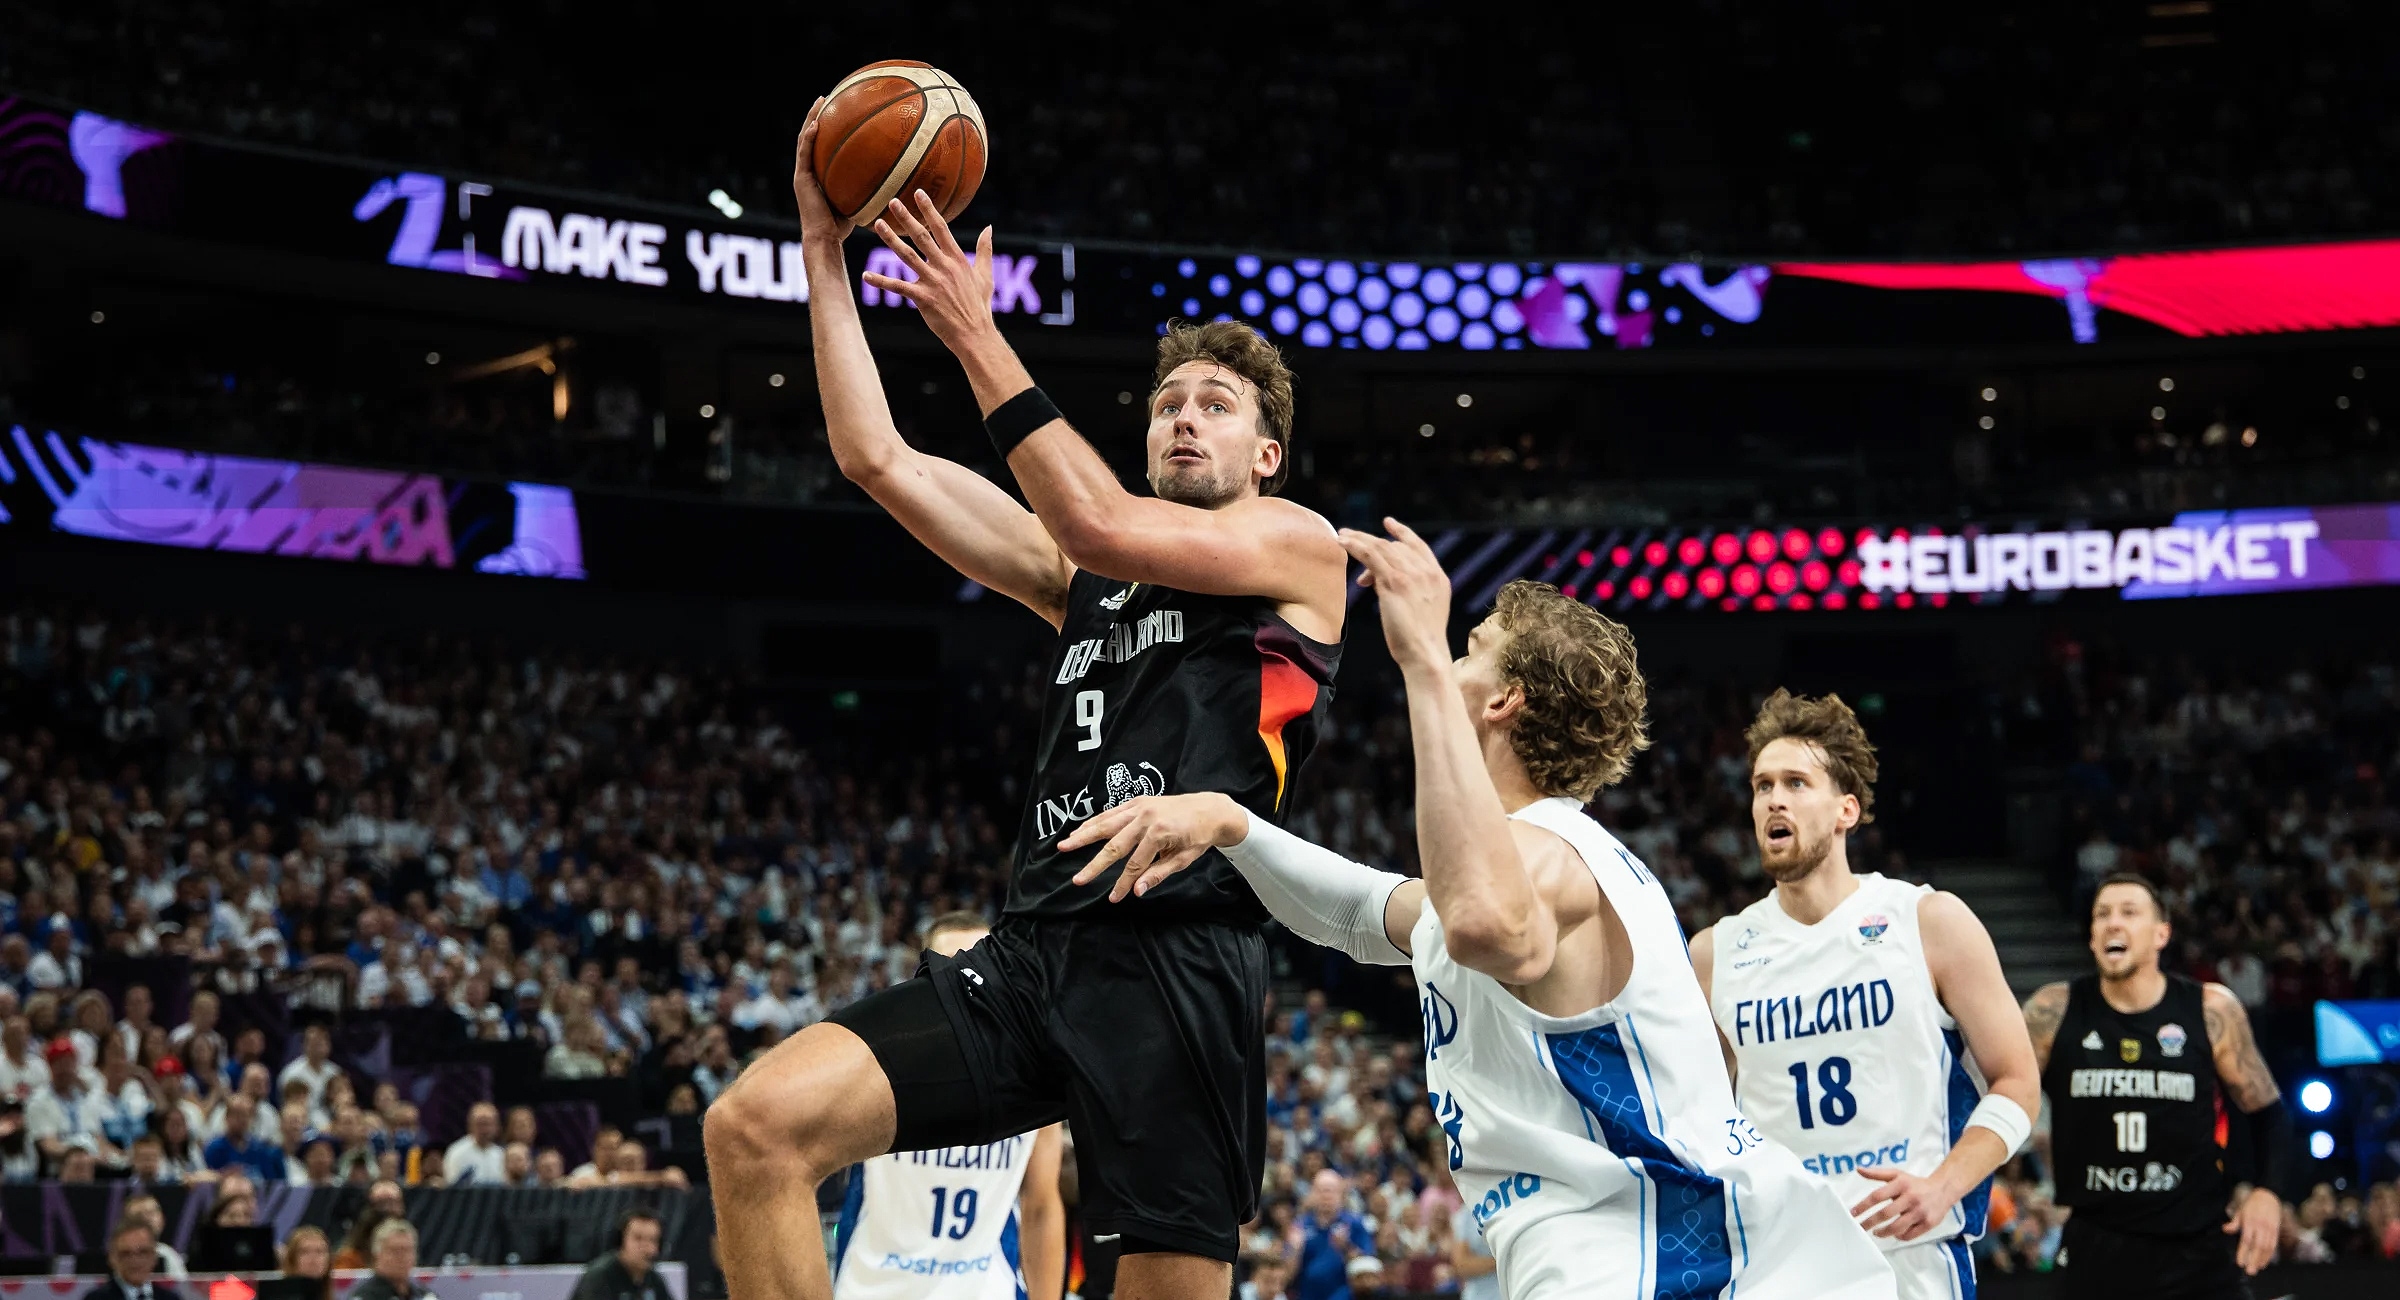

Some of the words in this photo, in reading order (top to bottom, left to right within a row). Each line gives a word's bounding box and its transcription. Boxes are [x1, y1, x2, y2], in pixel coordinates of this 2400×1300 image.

[501, 205, 670, 287] MAKE
[684, 228, 811, 303] YOU
[1857, 520, 2321, 595] #EUROBASKET
[1055, 609, 1184, 685] DEUHLAND
[1075, 689, 1105, 752] 9
[1035, 786, 1095, 841] ING
[1735, 978, 1895, 1047] FINLAND
[1788, 1056, 1857, 1130] 18
[2069, 1068, 2196, 1103] DEUTSCHLAND
[1802, 1138, 1910, 1176] stnord
[2112, 1111, 2148, 1153] 10
[2085, 1164, 2138, 1193] ING
[931, 1187, 978, 1240] 19
